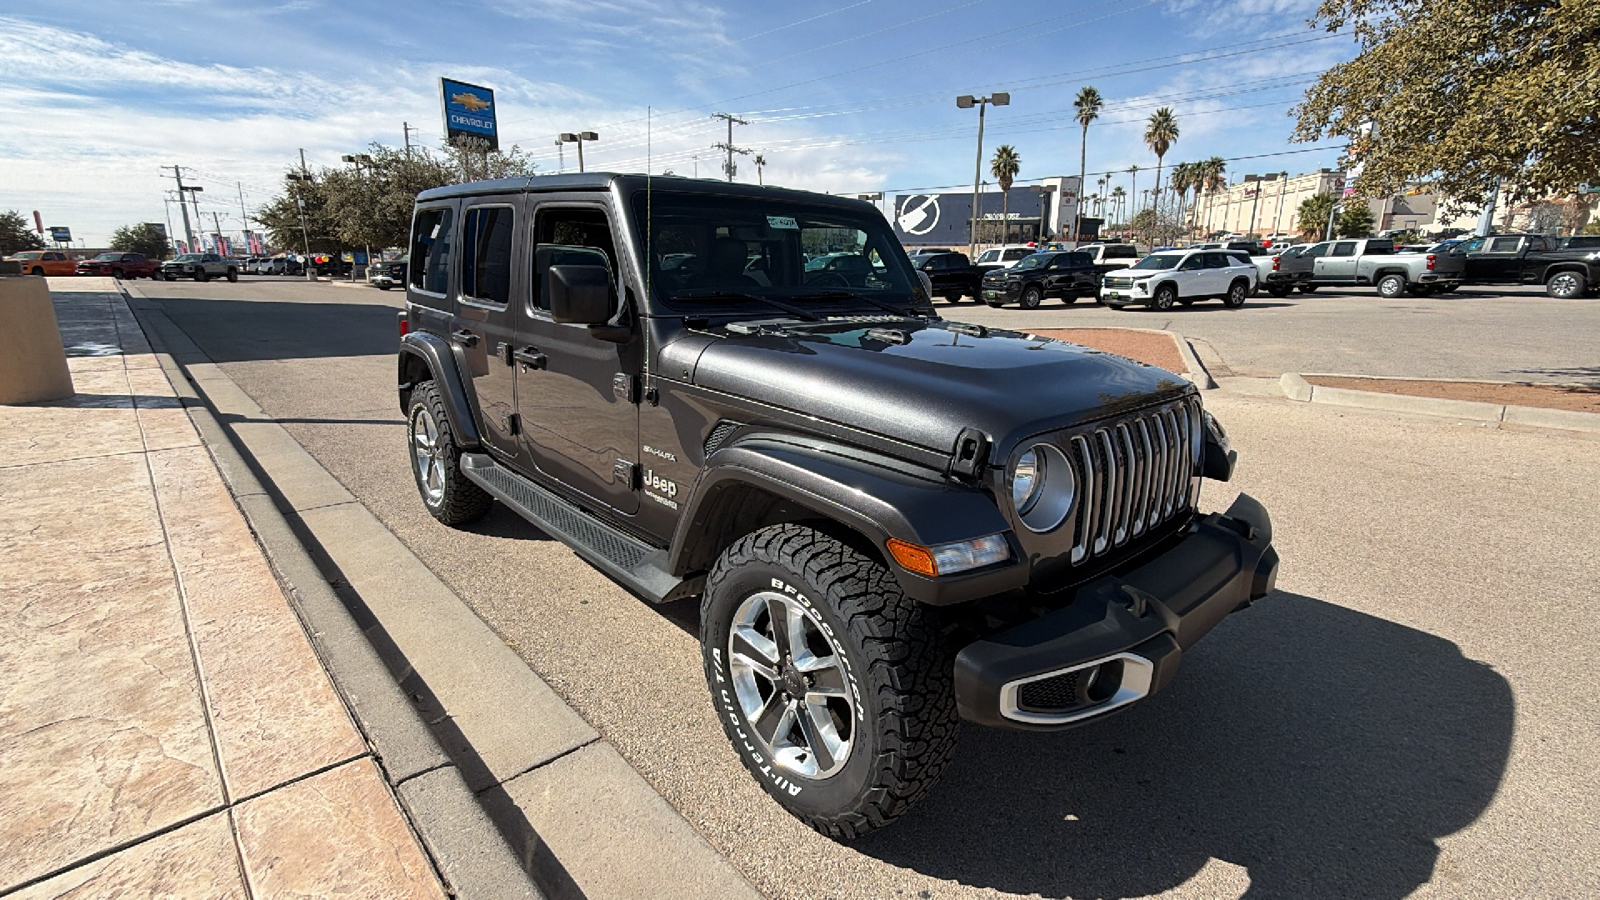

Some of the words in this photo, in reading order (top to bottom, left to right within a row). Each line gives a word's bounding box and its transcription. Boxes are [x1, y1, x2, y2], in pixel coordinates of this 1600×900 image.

[451, 115, 493, 129] CHEVROLET
[643, 445, 676, 462] SAHARA
[643, 469, 677, 499] Jeep
[712, 647, 726, 684] T/A
